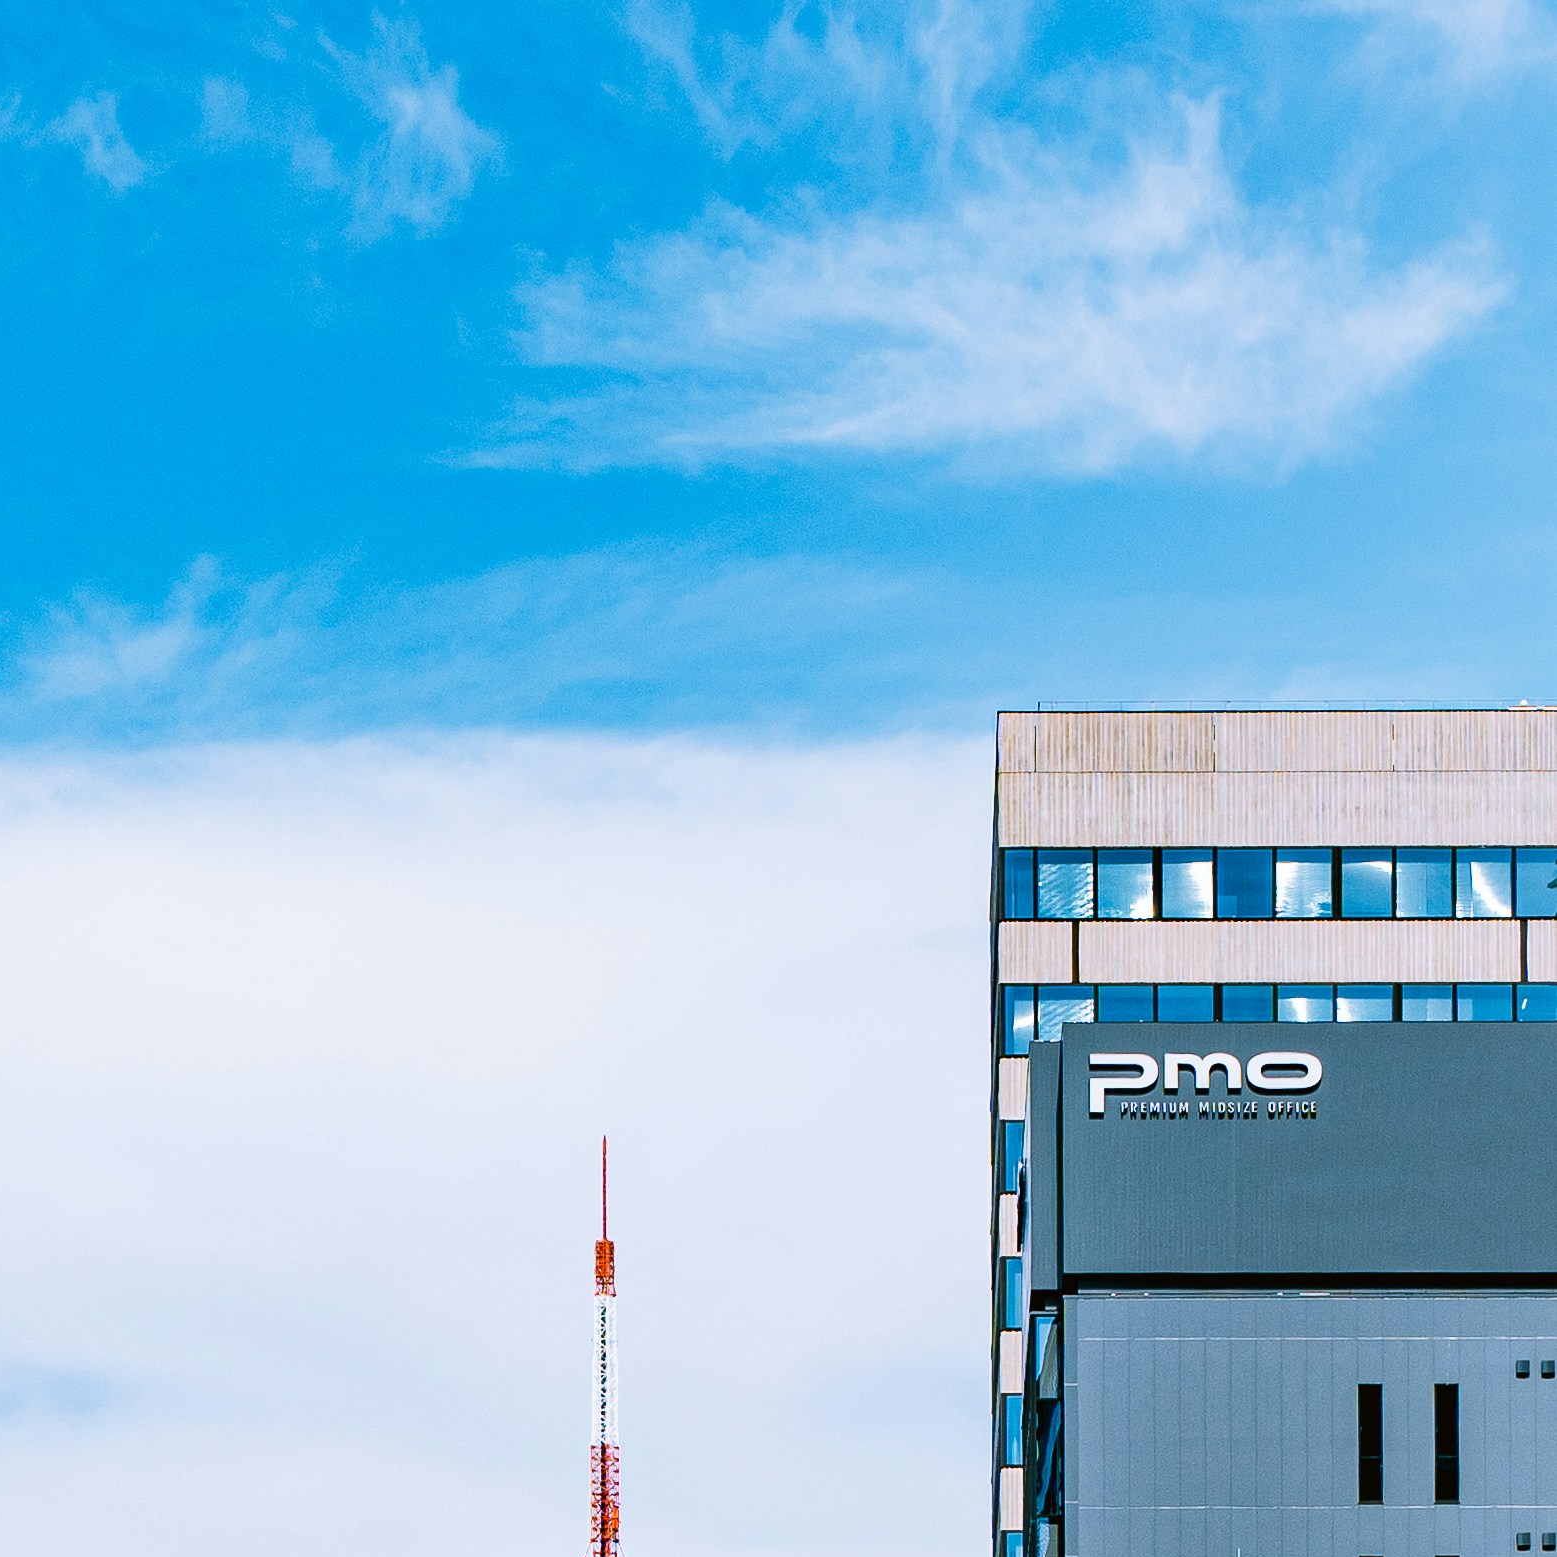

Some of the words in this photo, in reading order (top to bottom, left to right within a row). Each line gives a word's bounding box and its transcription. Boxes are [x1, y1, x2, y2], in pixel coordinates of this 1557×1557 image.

[1120, 1101, 1190, 1114] PREMIUM
[1199, 1101, 1259, 1114] MIDSIZE
[1268, 1101, 1318, 1114] OFFICE
